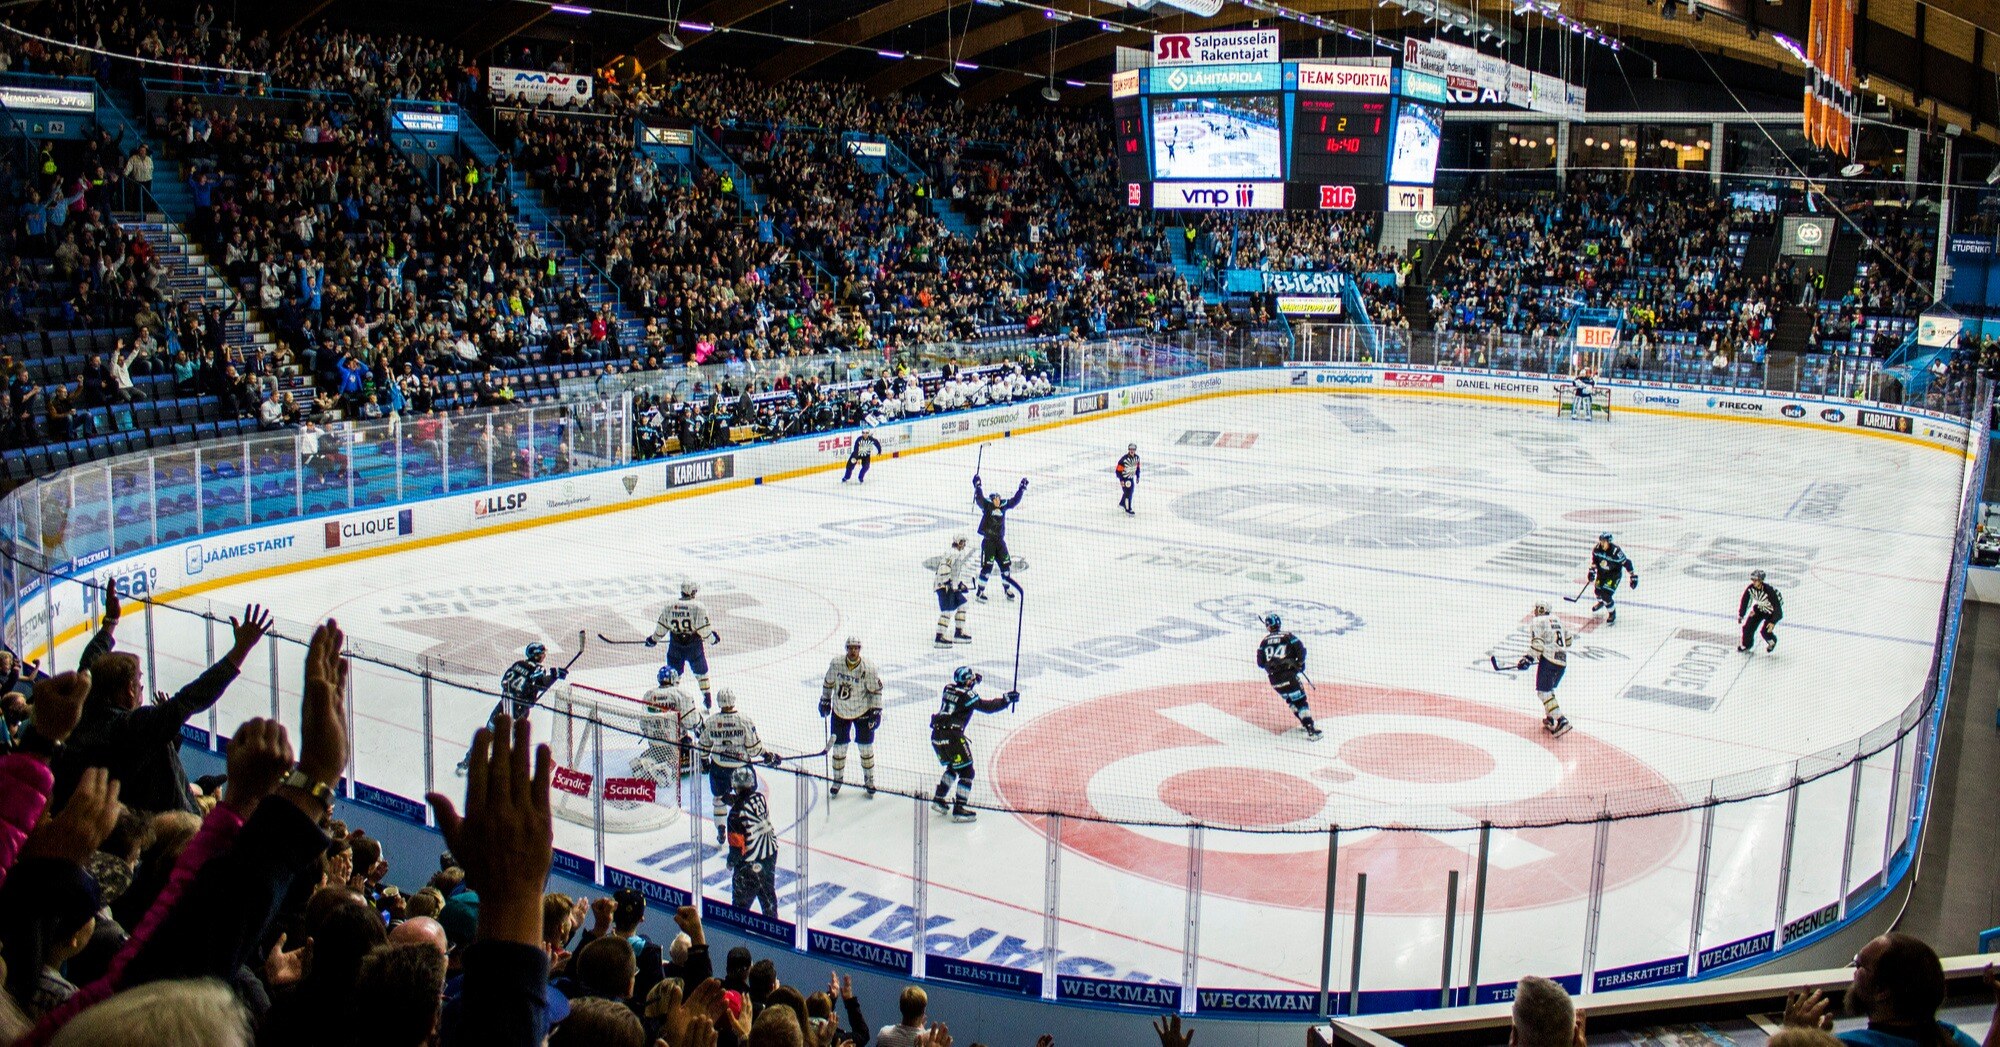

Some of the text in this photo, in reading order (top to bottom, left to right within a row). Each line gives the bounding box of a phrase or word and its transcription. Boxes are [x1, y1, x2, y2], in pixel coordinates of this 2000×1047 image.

[1194, 33, 1276, 49] Salpausselän
[1201, 48, 1268, 62] Rakentajat
[1190, 71, 1263, 85] LÄHITAPIOLA
[1300, 71, 1388, 87] TEAM SPORTIA
[1321, 115, 1381, 134] 1 2 1
[1326, 137, 1360, 153] 16:40
[1182, 189, 1228, 207] vmp
[1326, 374, 1373, 384] markprint
[1456, 379, 1490, 390] DANIEL
[1494, 382, 1539, 393] HECHTER
[1645, 395, 1679, 405] peikko
[1719, 401, 1763, 411] FIRECON
[1864, 413, 1896, 430] KARJALA
[674, 460, 712, 485] KARJALA
[488, 492, 527, 513] LLSP
[343, 517, 395, 538] CLIQUE
[77, 549, 109, 568] WECKMAN
[204, 536, 295, 564] JÄÄMESTARIT
[671, 619, 692, 633] 39
[710, 729, 743, 738] RANTAKARI
[555, 773, 586, 791] Scandic
[609, 784, 651, 797] Scandic
[610, 870, 685, 907] WECKMAN
[707, 903, 789, 937] TERÄSKATTEET
[1781, 903, 1840, 943] GREENLED
[812, 933, 908, 969] WECKMAN
[1701, 935, 1771, 969] WECKMAN
[943, 960, 1019, 986] TERÄSTIILI
[1597, 962, 1684, 988] TERÄSKATTEET
[1061, 979, 1174, 1005] WECKMAN
[1200, 992, 1314, 1011] WECKMAN
